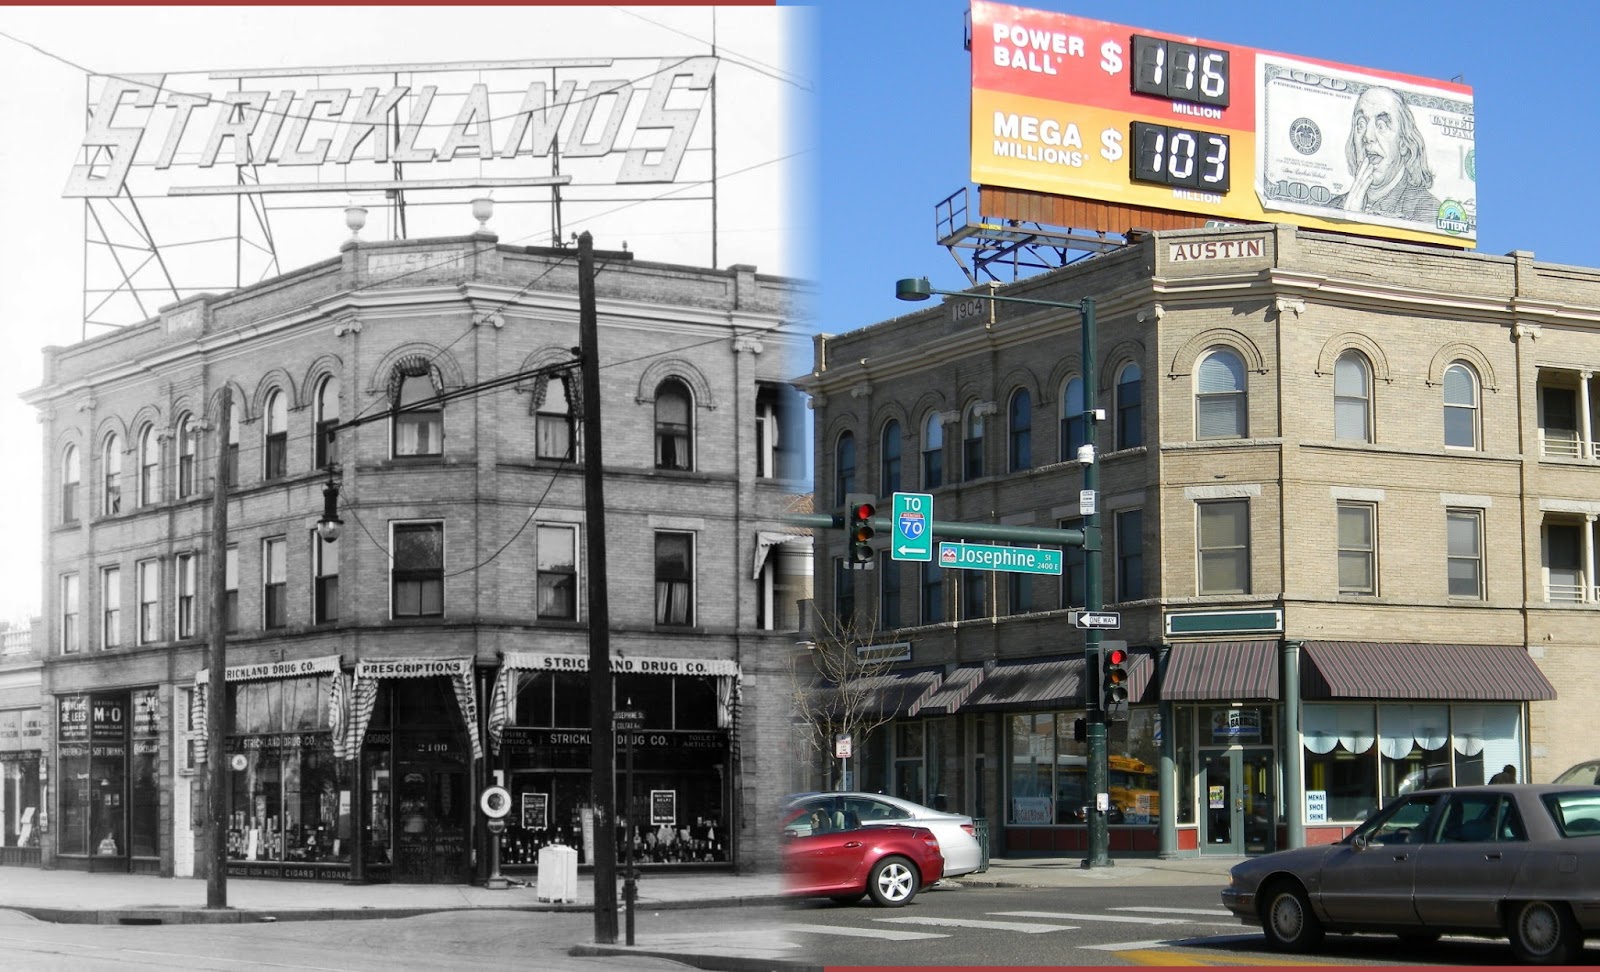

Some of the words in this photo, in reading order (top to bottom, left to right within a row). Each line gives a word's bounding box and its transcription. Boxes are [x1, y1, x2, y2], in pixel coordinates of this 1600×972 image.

[992, 23, 1085, 58] POWER
[993, 46, 1057, 75] BALL
[1100, 40, 1123, 75] $
[1153, 47, 1226, 97] 116
[1172, 102, 1222, 120] MILLION
[62, 56, 719, 198] STRICKLANDS
[993, 111, 1083, 149] MEGA
[993, 140, 1083, 168] MILLIONS
[1100, 127, 1123, 162] $
[1153, 132, 1227, 183] 103
[1172, 189, 1222, 204] MILLION
[1276, 179, 1331, 203] 100
[1437, 219, 1468, 232] LOTTERY
[1174, 239, 1262, 261] AUSTIN
[955, 298, 983, 321] 1904
[903, 497, 922, 511] TO
[902, 522, 922, 535] 70
[959, 547, 1035, 568] Josephine
[1037, 562, 1054, 570] 2400
[1090, 616, 1101, 624] ONE
[226, 665, 269, 680] RICKLAND
[272, 663, 297, 675] DRUG
[300, 661, 315, 671] CO.
[363, 662, 461, 674] PRESCRIPTIONS
[544, 657, 633, 670] STRICAND
[641, 660, 678, 672] DRUG
[686, 662, 707, 673] CO.
[284, 736, 302, 748] DRUG
[417, 743, 448, 752] 2100
[550, 733, 592, 745] STRICKL
[650, 735, 669, 746] CO.
[1309, 803, 1324, 811] SHOE
[285, 869, 314, 878] CIGARS
[321, 870, 352, 880] KODAKS
